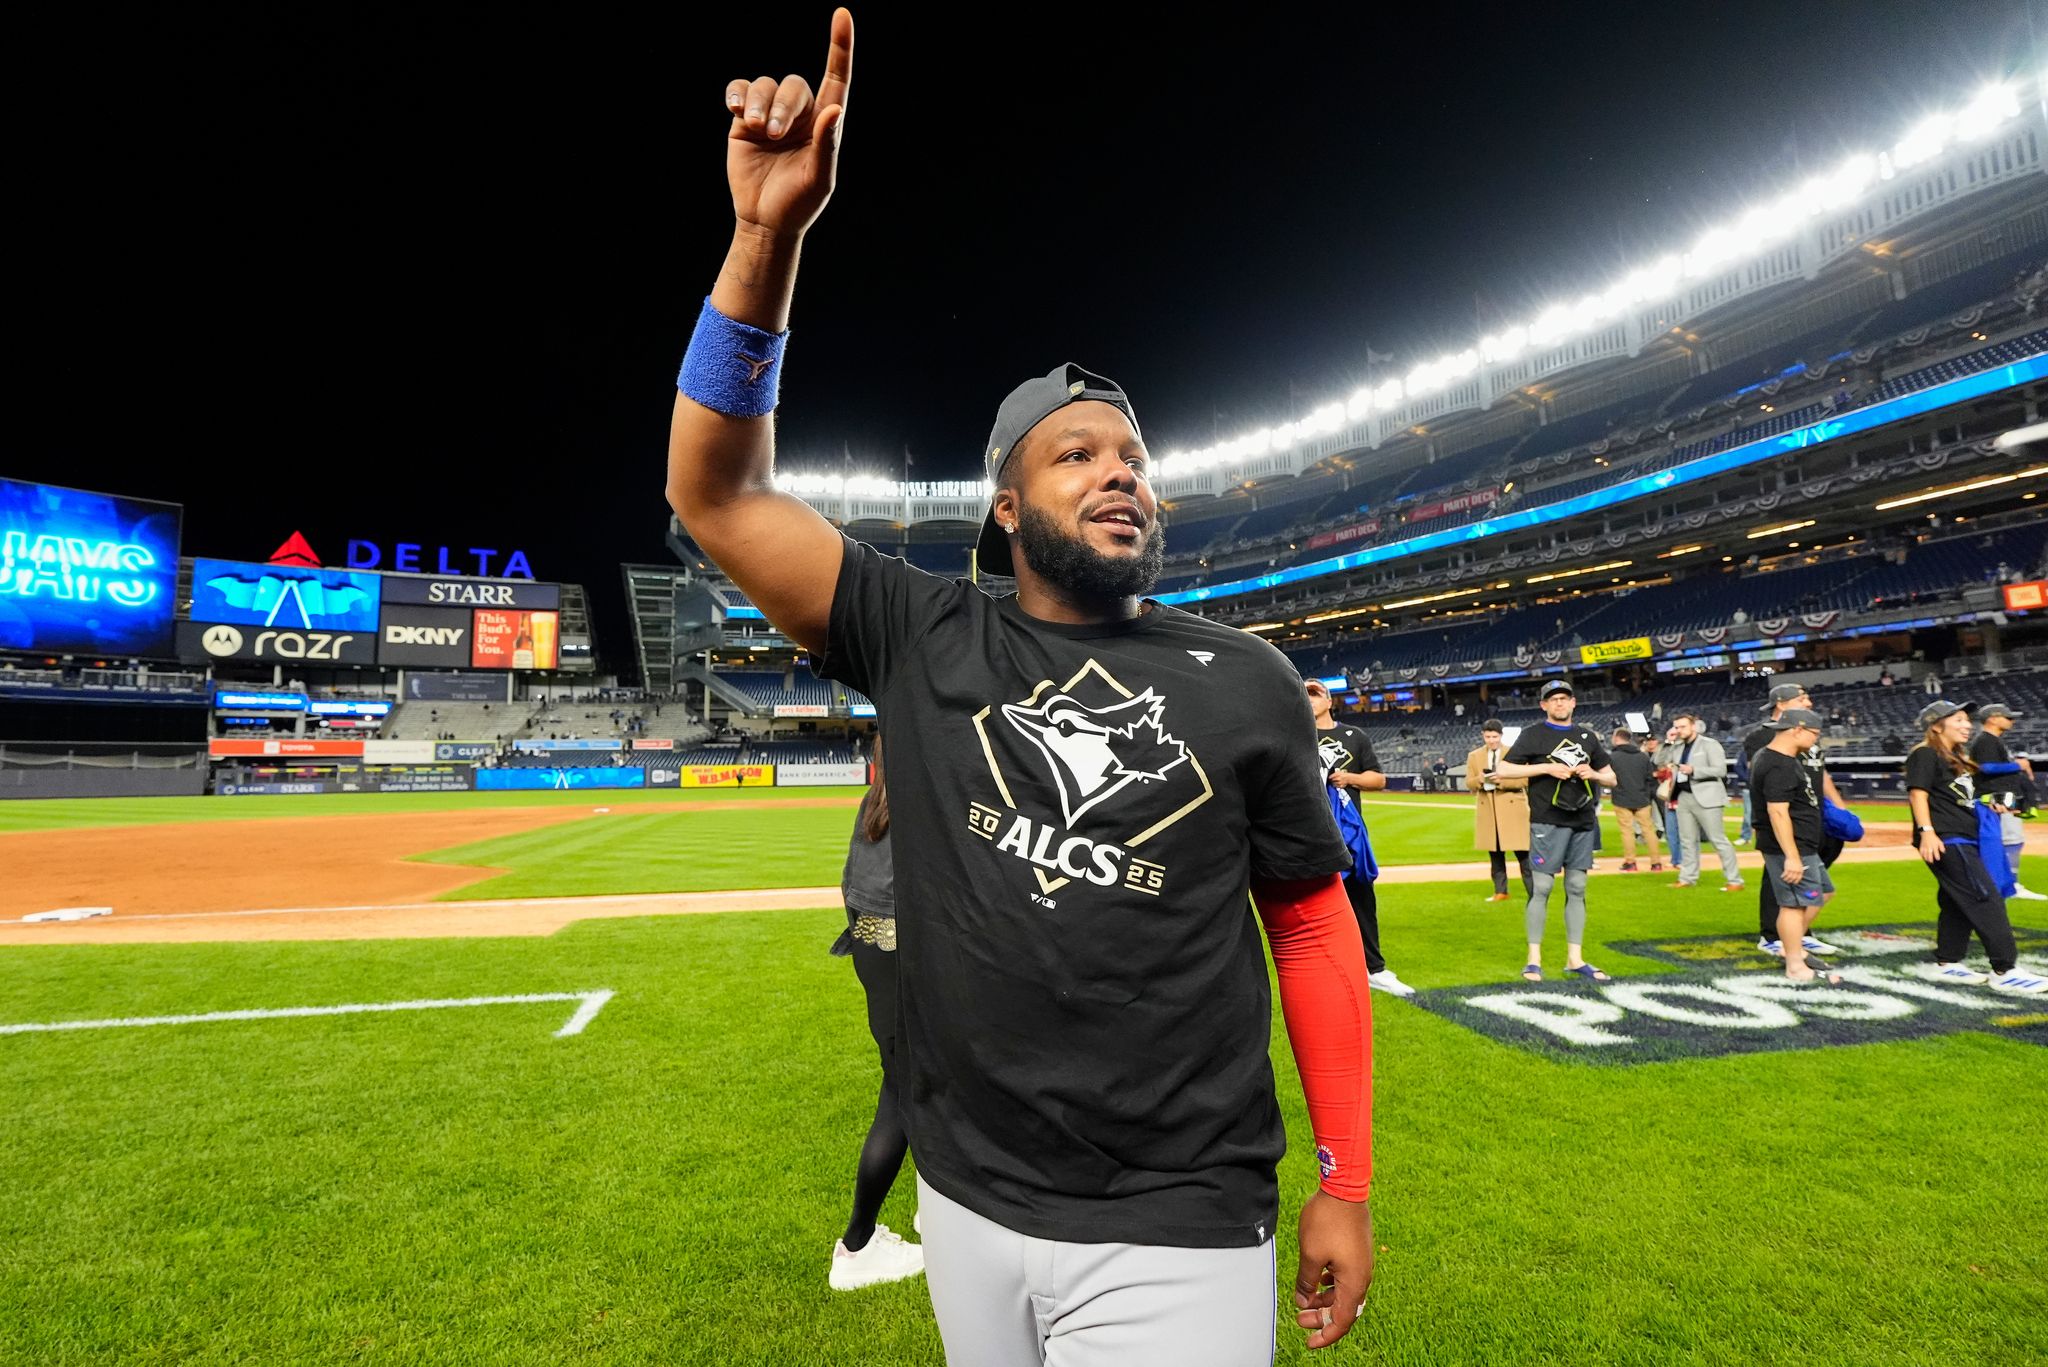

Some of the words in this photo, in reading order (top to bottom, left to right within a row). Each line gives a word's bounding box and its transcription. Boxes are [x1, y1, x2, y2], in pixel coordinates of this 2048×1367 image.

[1442, 499, 1470, 514] PARTY
[1471, 490, 1497, 505] DECK
[1335, 526, 1358, 541] PARTY
[1358, 521, 1378, 536] DECK
[347, 539, 535, 580] DELTA
[428, 582, 516, 606] STARR
[477, 612, 507, 624] This
[478, 623, 512, 634] Bud's
[254, 630, 354, 660] razr
[386, 625, 465, 646] DKNY
[478, 633, 500, 644] For
[477, 643, 505, 655] You.
[968, 808, 999, 833] 20
[996, 814, 1123, 886] ALCS
[1126, 864, 1164, 889] 25
